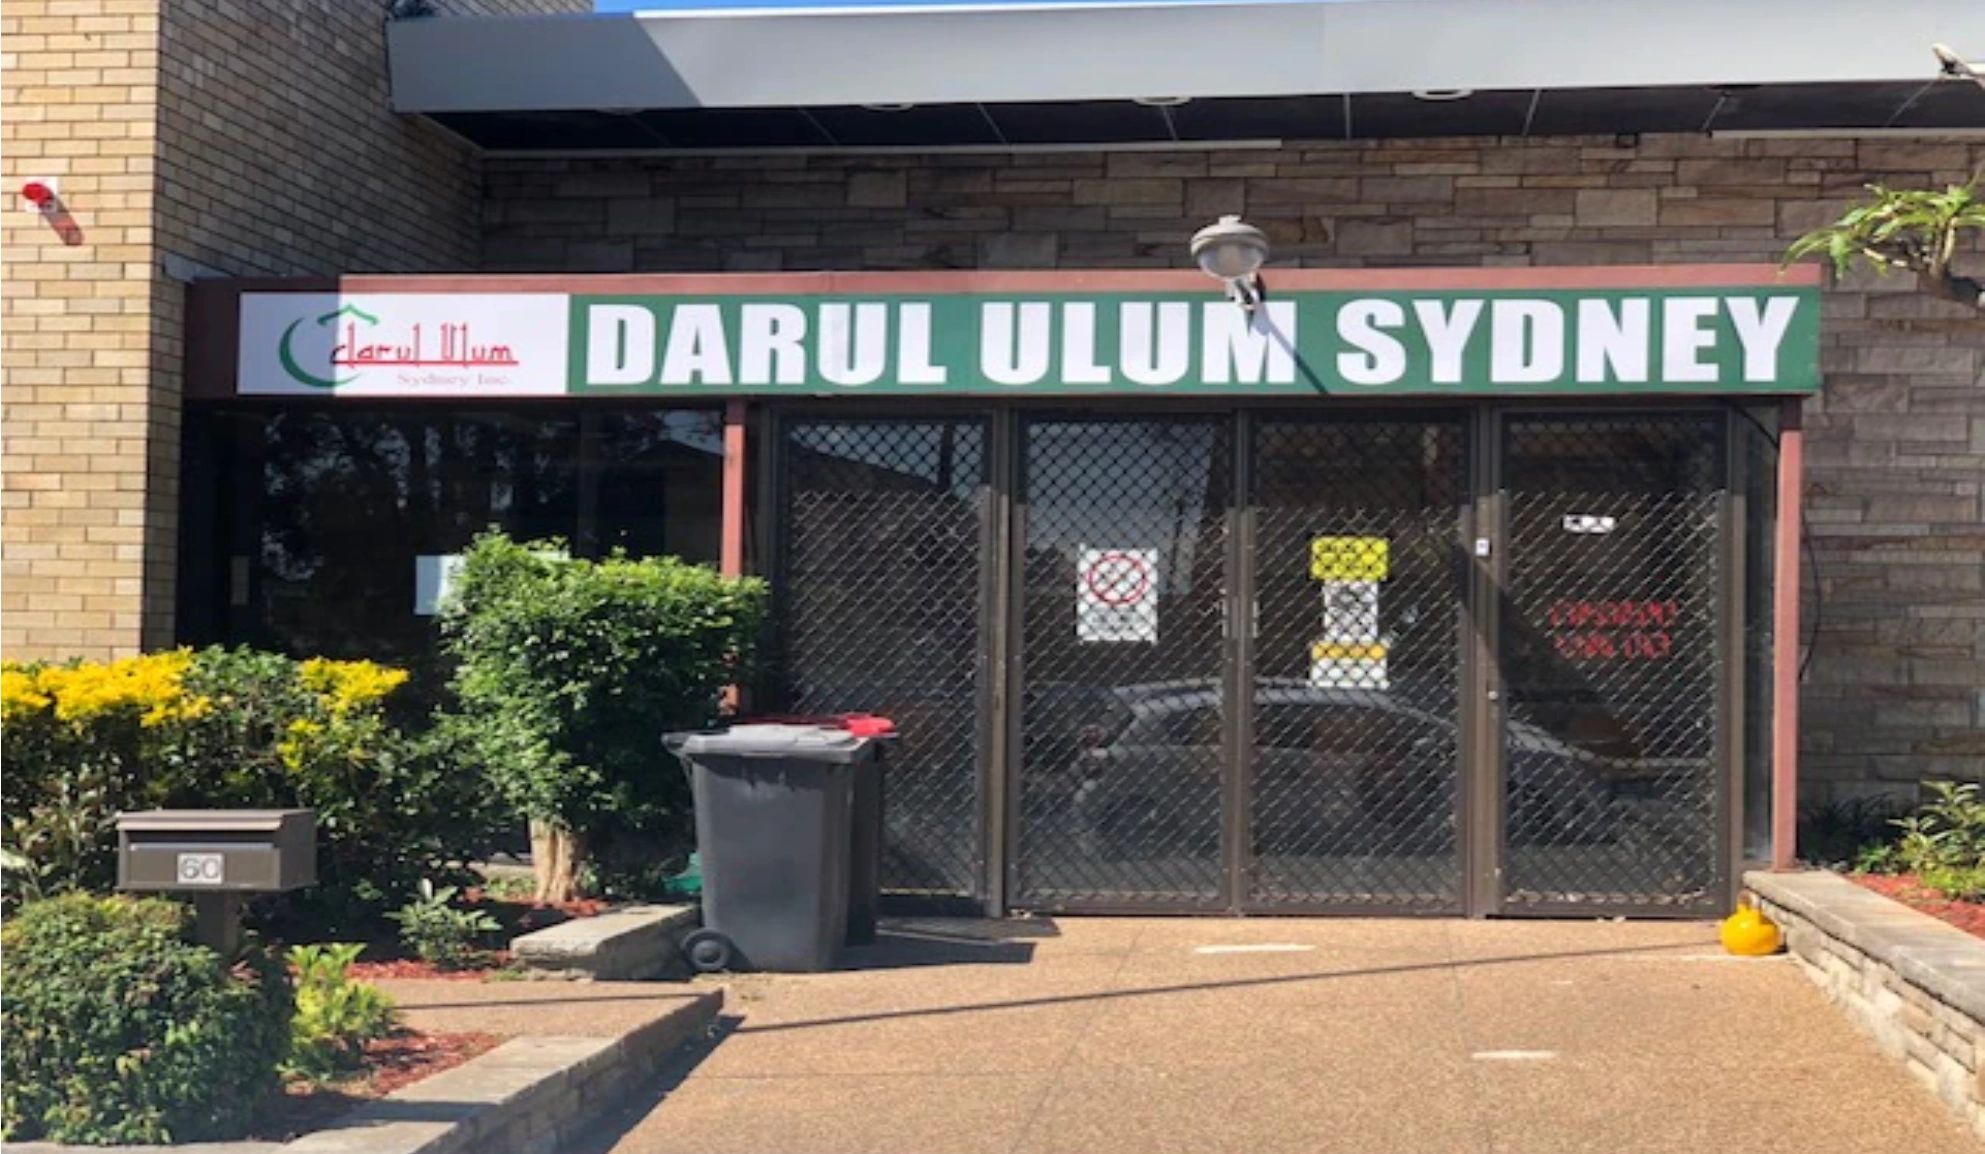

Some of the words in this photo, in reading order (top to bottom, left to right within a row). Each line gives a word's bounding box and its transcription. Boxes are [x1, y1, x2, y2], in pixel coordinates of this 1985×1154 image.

[330, 322, 420, 368] darul
[586, 302, 947, 386] DARUL
[980, 301, 1297, 386] ULUM
[1335, 296, 1799, 386] SYDNEY
[181, 857, 221, 879] 60
